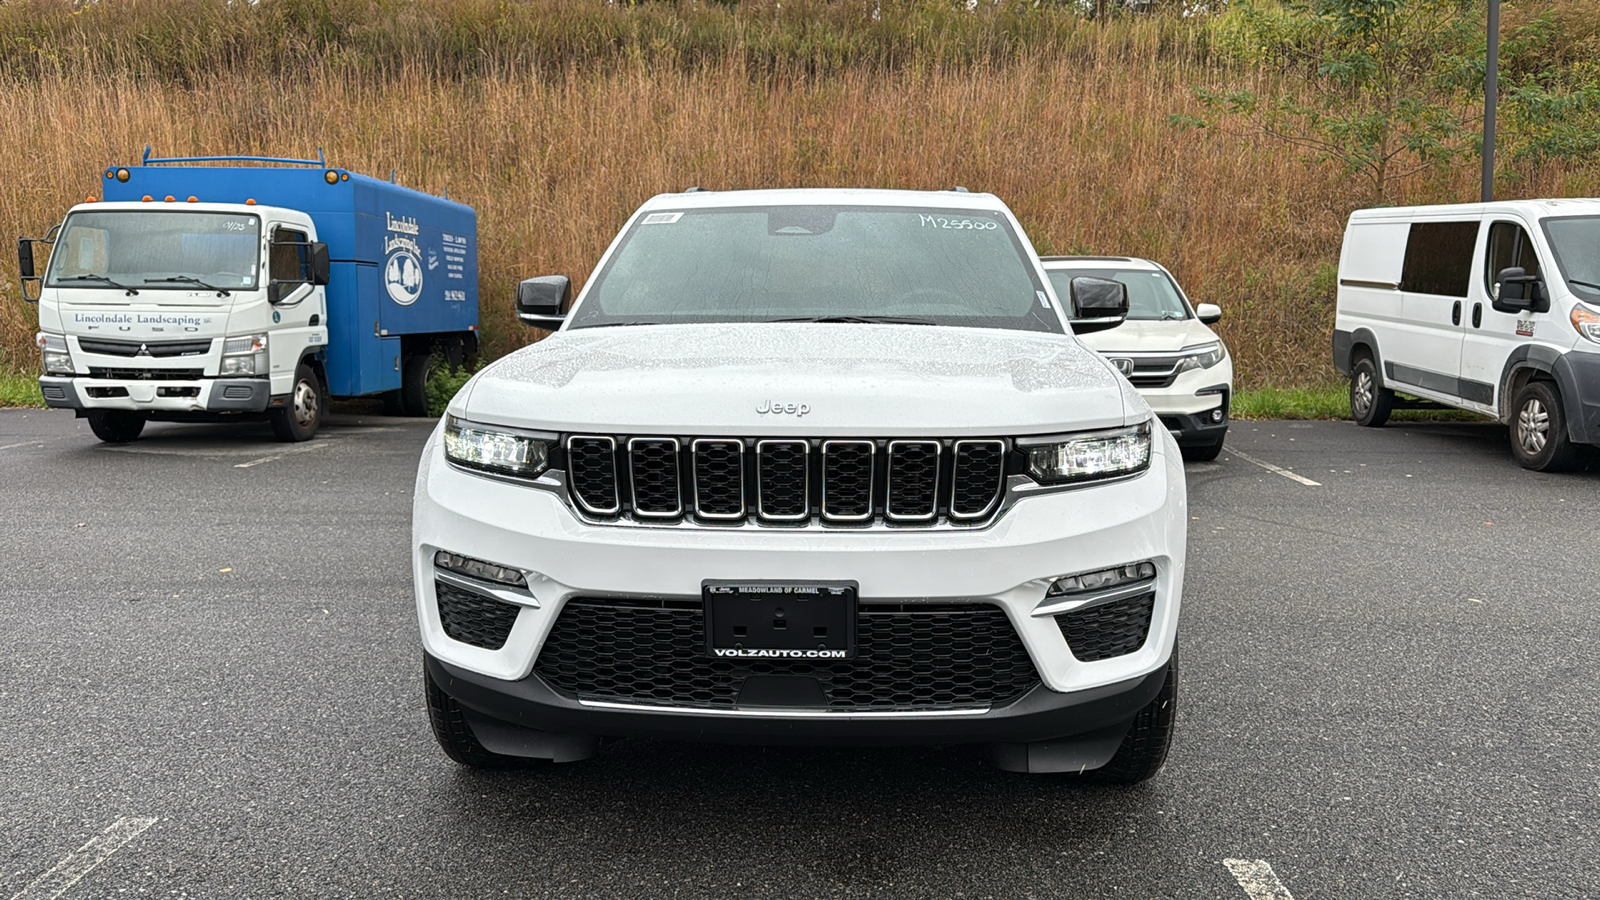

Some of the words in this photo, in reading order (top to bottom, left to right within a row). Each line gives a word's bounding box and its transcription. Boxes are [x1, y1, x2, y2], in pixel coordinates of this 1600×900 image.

[75, 313, 132, 323] Lincolndale
[137, 314, 201, 326] Landscaping
[756, 399, 811, 418] Jeep
[738, 586, 783, 594] MEADOWLAND
[714, 649, 846, 658] VOLZAUTO.COM
